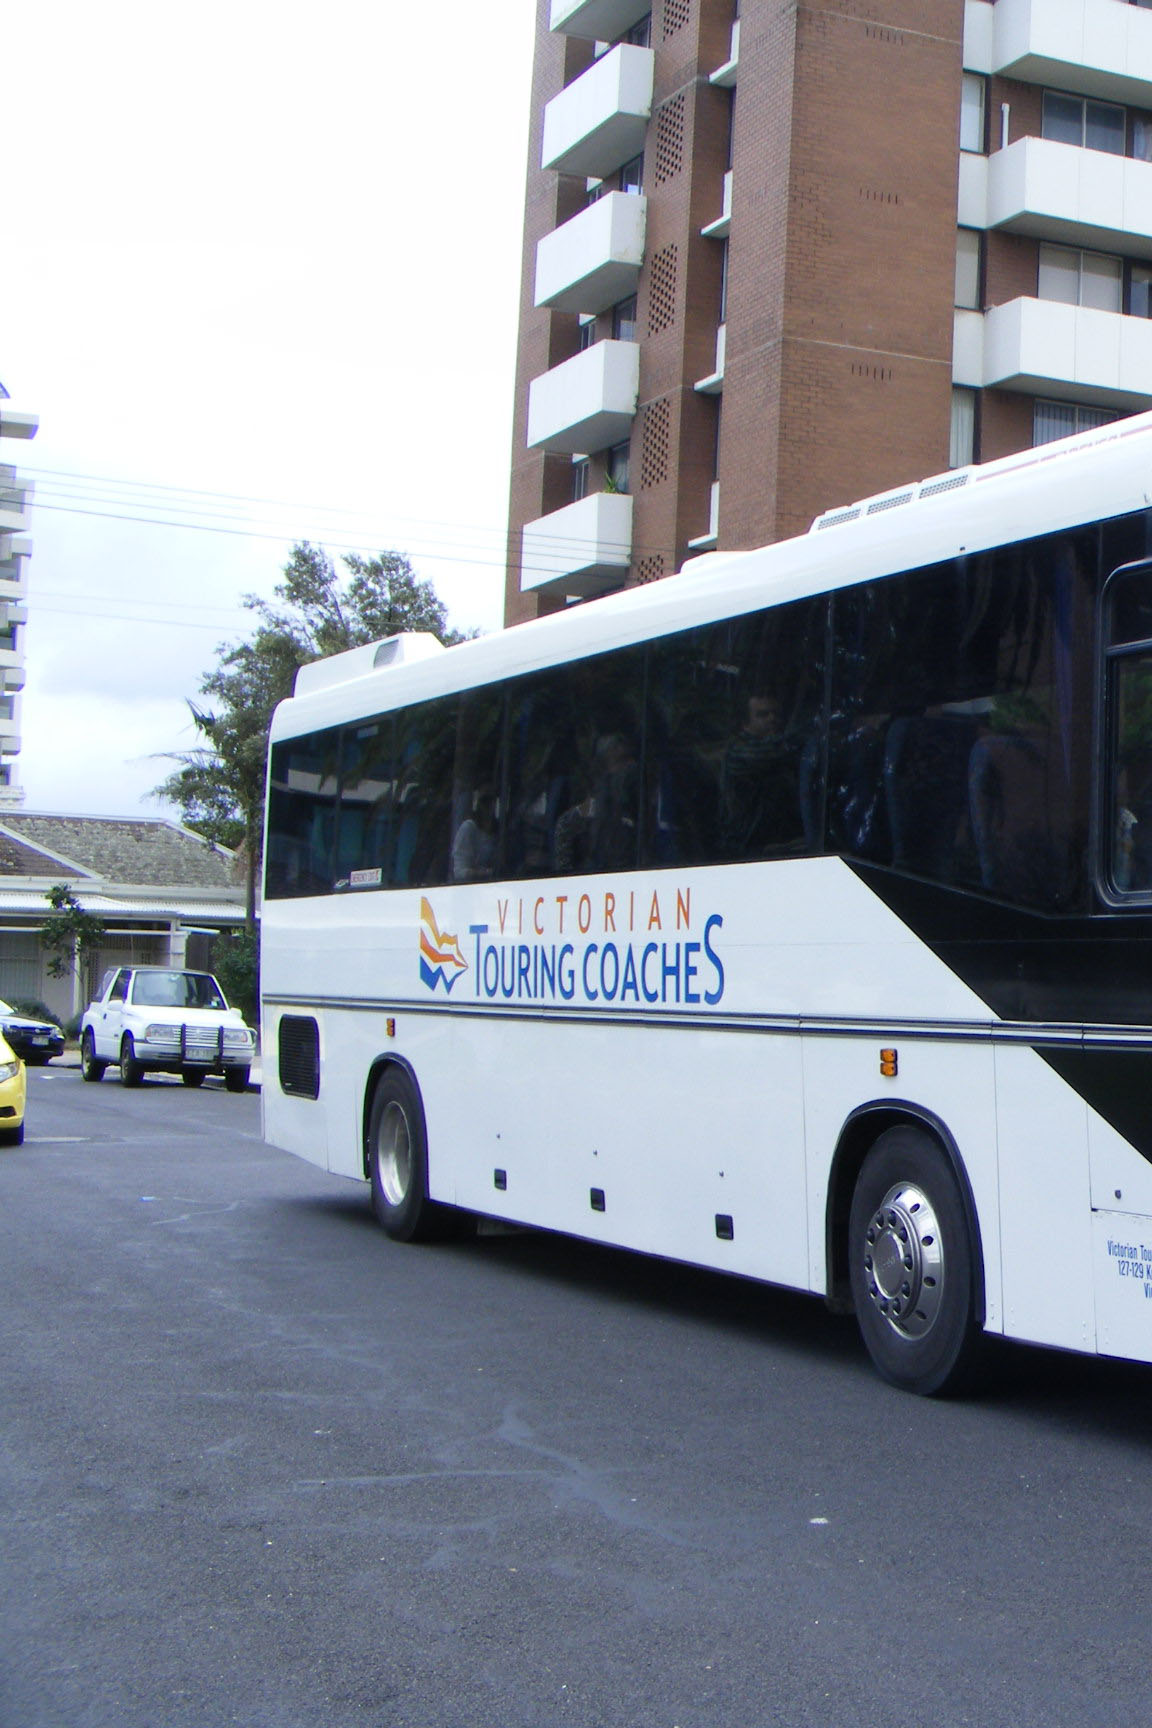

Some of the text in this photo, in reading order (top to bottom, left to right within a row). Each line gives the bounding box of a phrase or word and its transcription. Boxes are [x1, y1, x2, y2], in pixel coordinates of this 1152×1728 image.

[497, 887, 691, 936] VICTORIAN
[469, 913, 726, 1006] TOURING COACHES
[1107, 1239, 1138, 1259] Victorian
[1117, 1260, 1144, 1279] 127-129
